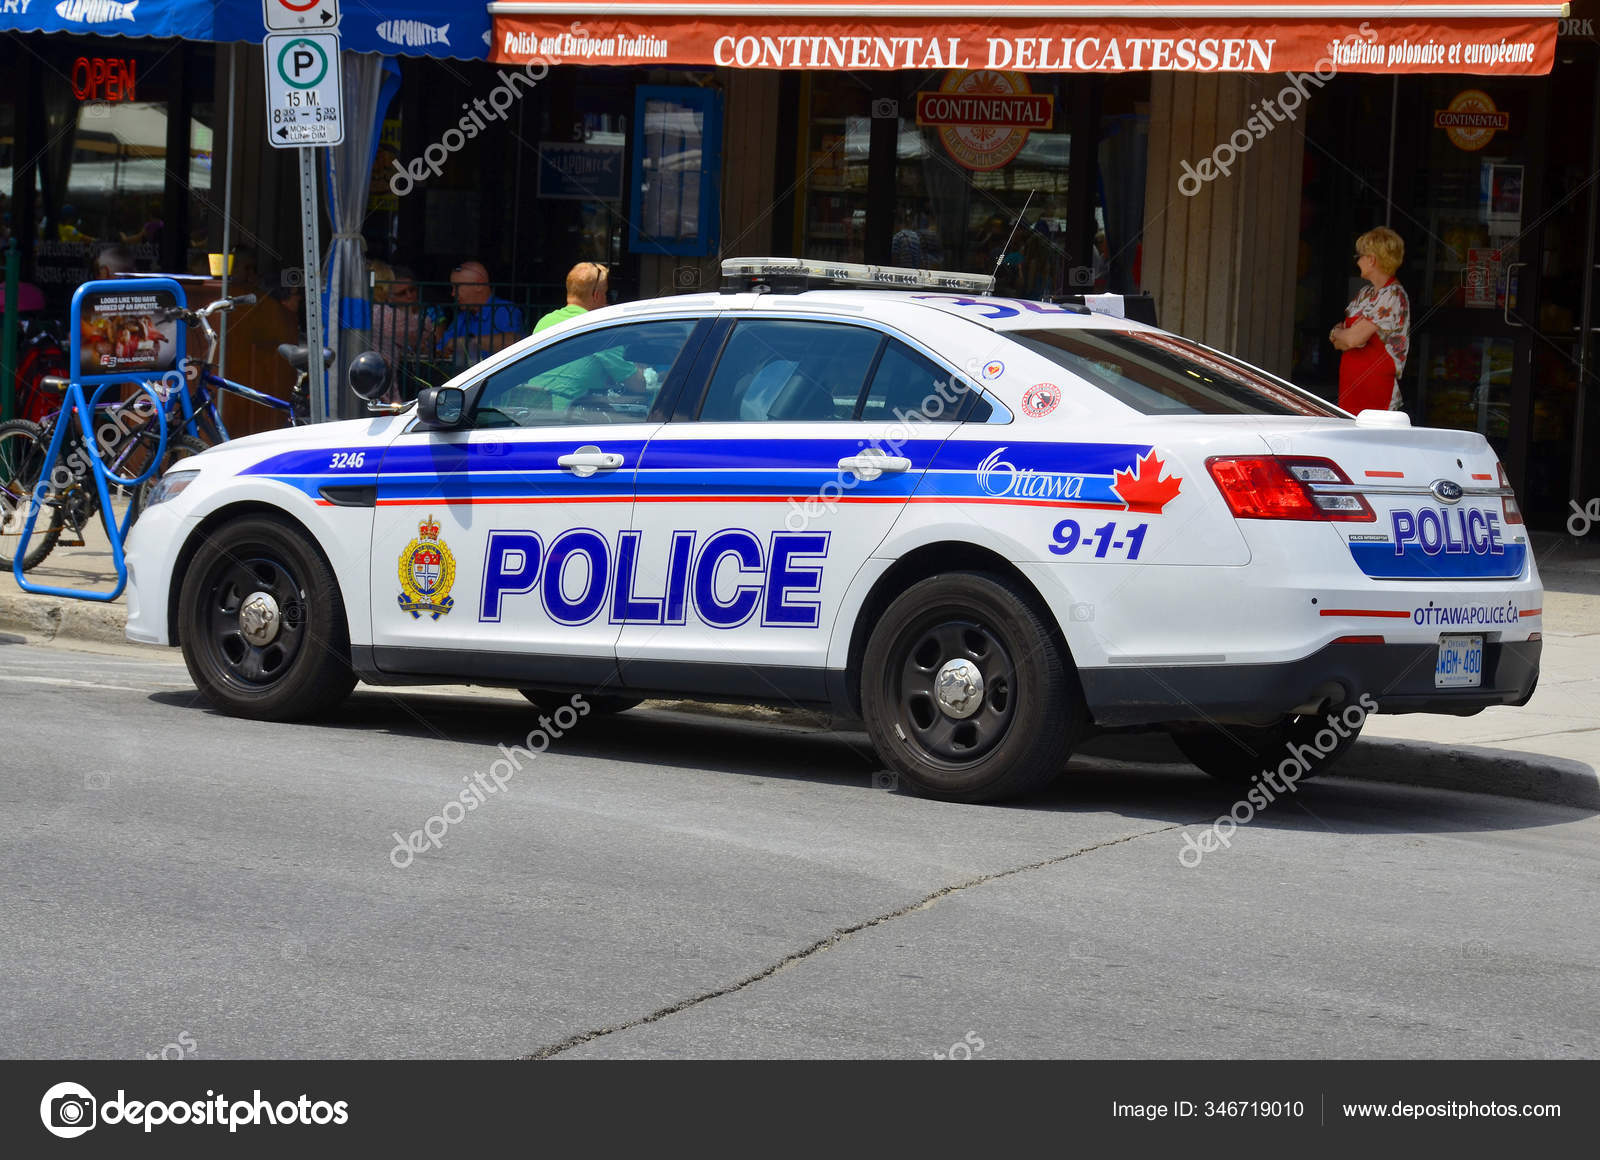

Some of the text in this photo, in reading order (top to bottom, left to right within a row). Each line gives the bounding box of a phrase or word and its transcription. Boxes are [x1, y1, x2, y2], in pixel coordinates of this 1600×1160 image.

[386, 20, 438, 47] LAPOINTE
[504, 32, 668, 59] Polish and European Tradition
[294, 51, 314, 77] P
[713, 36, 1276, 71] CONTINENTAL DELICATESSEN
[1332, 38, 1535, 67] Tradition polonaise et européenne
[72, 57, 136, 101] OPEN
[287, 92, 300, 107] 15
[924, 98, 1045, 122] CONTINENTAL
[274, 109, 282, 123] 8
[316, 108, 322, 122] 5
[1438, 112, 1504, 127] CONTINENTAL
[329, 452, 365, 468] 3246
[977, 447, 1084, 498] Ottawa
[1048, 519, 1148, 560] 9-1-1
[1389, 507, 1504, 556] POLICE
[478, 527, 831, 630] POLICE
[1414, 606, 1519, 625] OTTAWAPOLICE.CA
